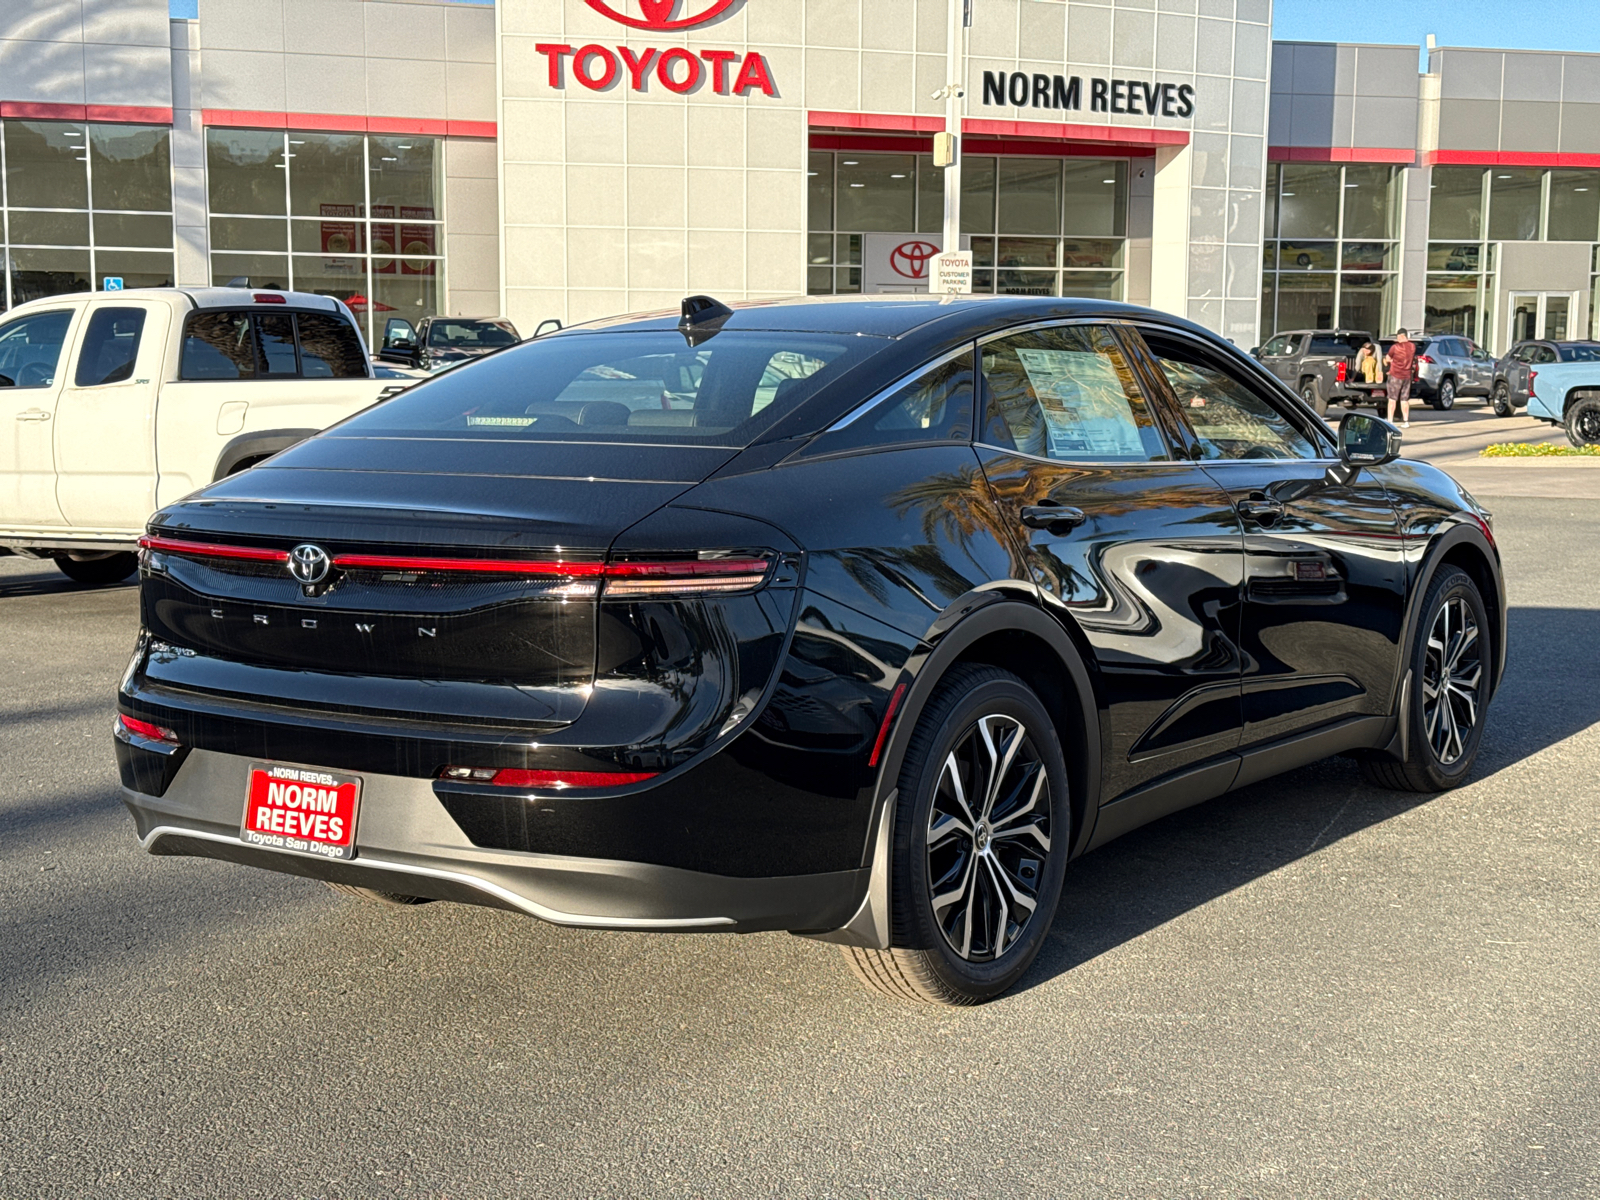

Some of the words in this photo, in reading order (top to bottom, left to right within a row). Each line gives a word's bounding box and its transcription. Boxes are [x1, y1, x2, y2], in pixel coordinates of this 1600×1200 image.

[535, 43, 774, 95] TOYOTA
[982, 70, 1081, 110] NORM
[1090, 77, 1193, 118] REEVES
[941, 259, 969, 267] TOYOTA
[210, 608, 437, 638] CROWN
[273, 767, 299, 780] NORM
[300, 771, 333, 785] REEVES
[267, 782, 338, 814] NORM
[256, 806, 344, 841] REEVES
[246, 830, 284, 846] Toyota
[285, 837, 308, 851] San
[310, 842, 344, 857] Diego
